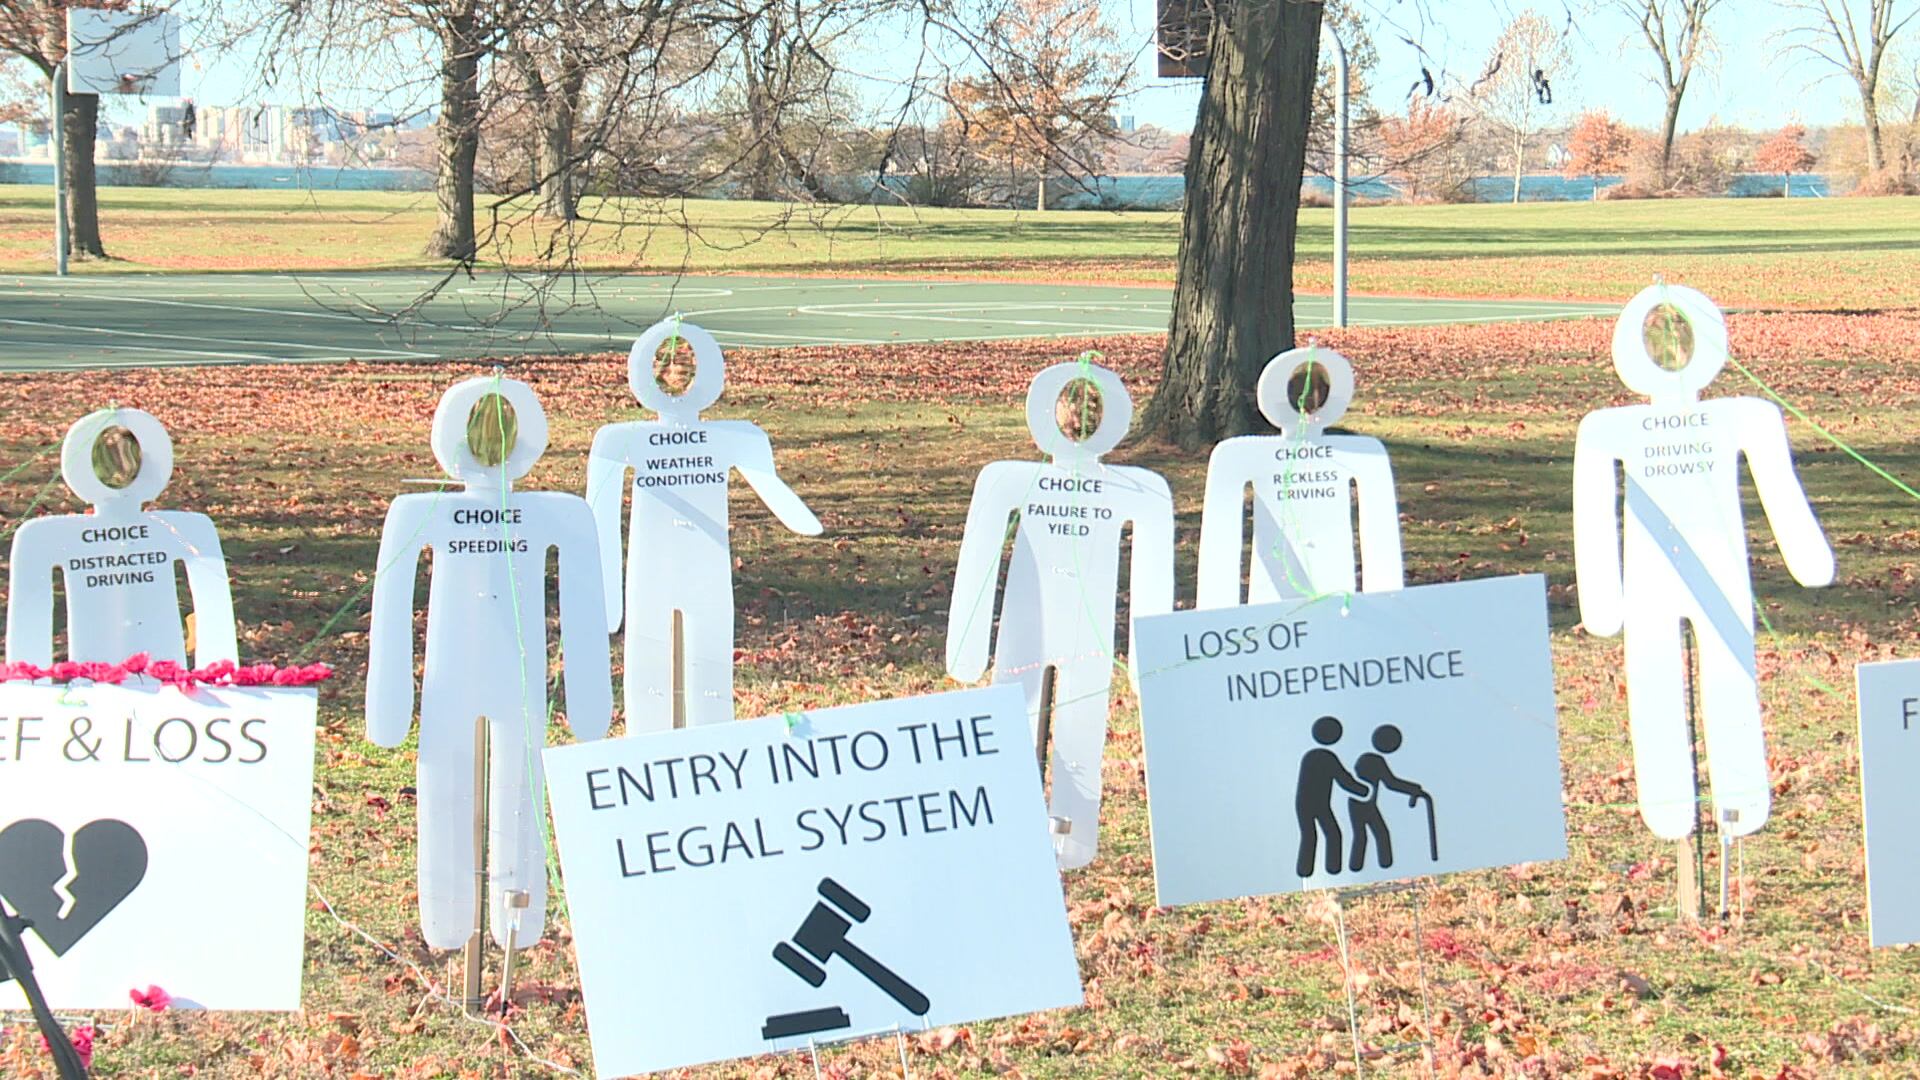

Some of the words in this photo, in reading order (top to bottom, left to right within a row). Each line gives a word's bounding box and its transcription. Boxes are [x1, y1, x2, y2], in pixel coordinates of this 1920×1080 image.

[1642, 413, 1709, 431] CHOICE
[649, 431, 707, 446] CHOICE
[1275, 446, 1333, 461] CHOICE
[1644, 442, 1712, 458] DRIVING
[646, 456, 713, 470] WEATHER
[1644, 460, 1714, 477] DROWSY
[636, 472, 725, 488] CONDITIONS
[1038, 477, 1103, 493] CHOICE
[453, 509, 522, 524] CHOICE
[1028, 504, 1088, 519] FAILURE
[1093, 508, 1112, 520] TO
[81, 525, 149, 543] CHOICE
[1048, 523, 1089, 536] YIELD
[448, 539, 528, 553] SPEEDING
[69, 551, 168, 571] DISTRACTED
[86, 571, 154, 588] DRIVING
[1183, 626, 1260, 661] LOSS
[1267, 621, 1308, 651] OF
[1227, 650, 1464, 702] INDEPENDENCE
[63, 716, 102, 762] &
[124, 717, 268, 764] LOSS
[585, 748, 748, 811] ENTRY
[766, 730, 889, 785] INTO
[897, 714, 1000, 764] THE
[616, 817, 784, 878] LEGAL
[796, 785, 994, 851] SYSTEM
